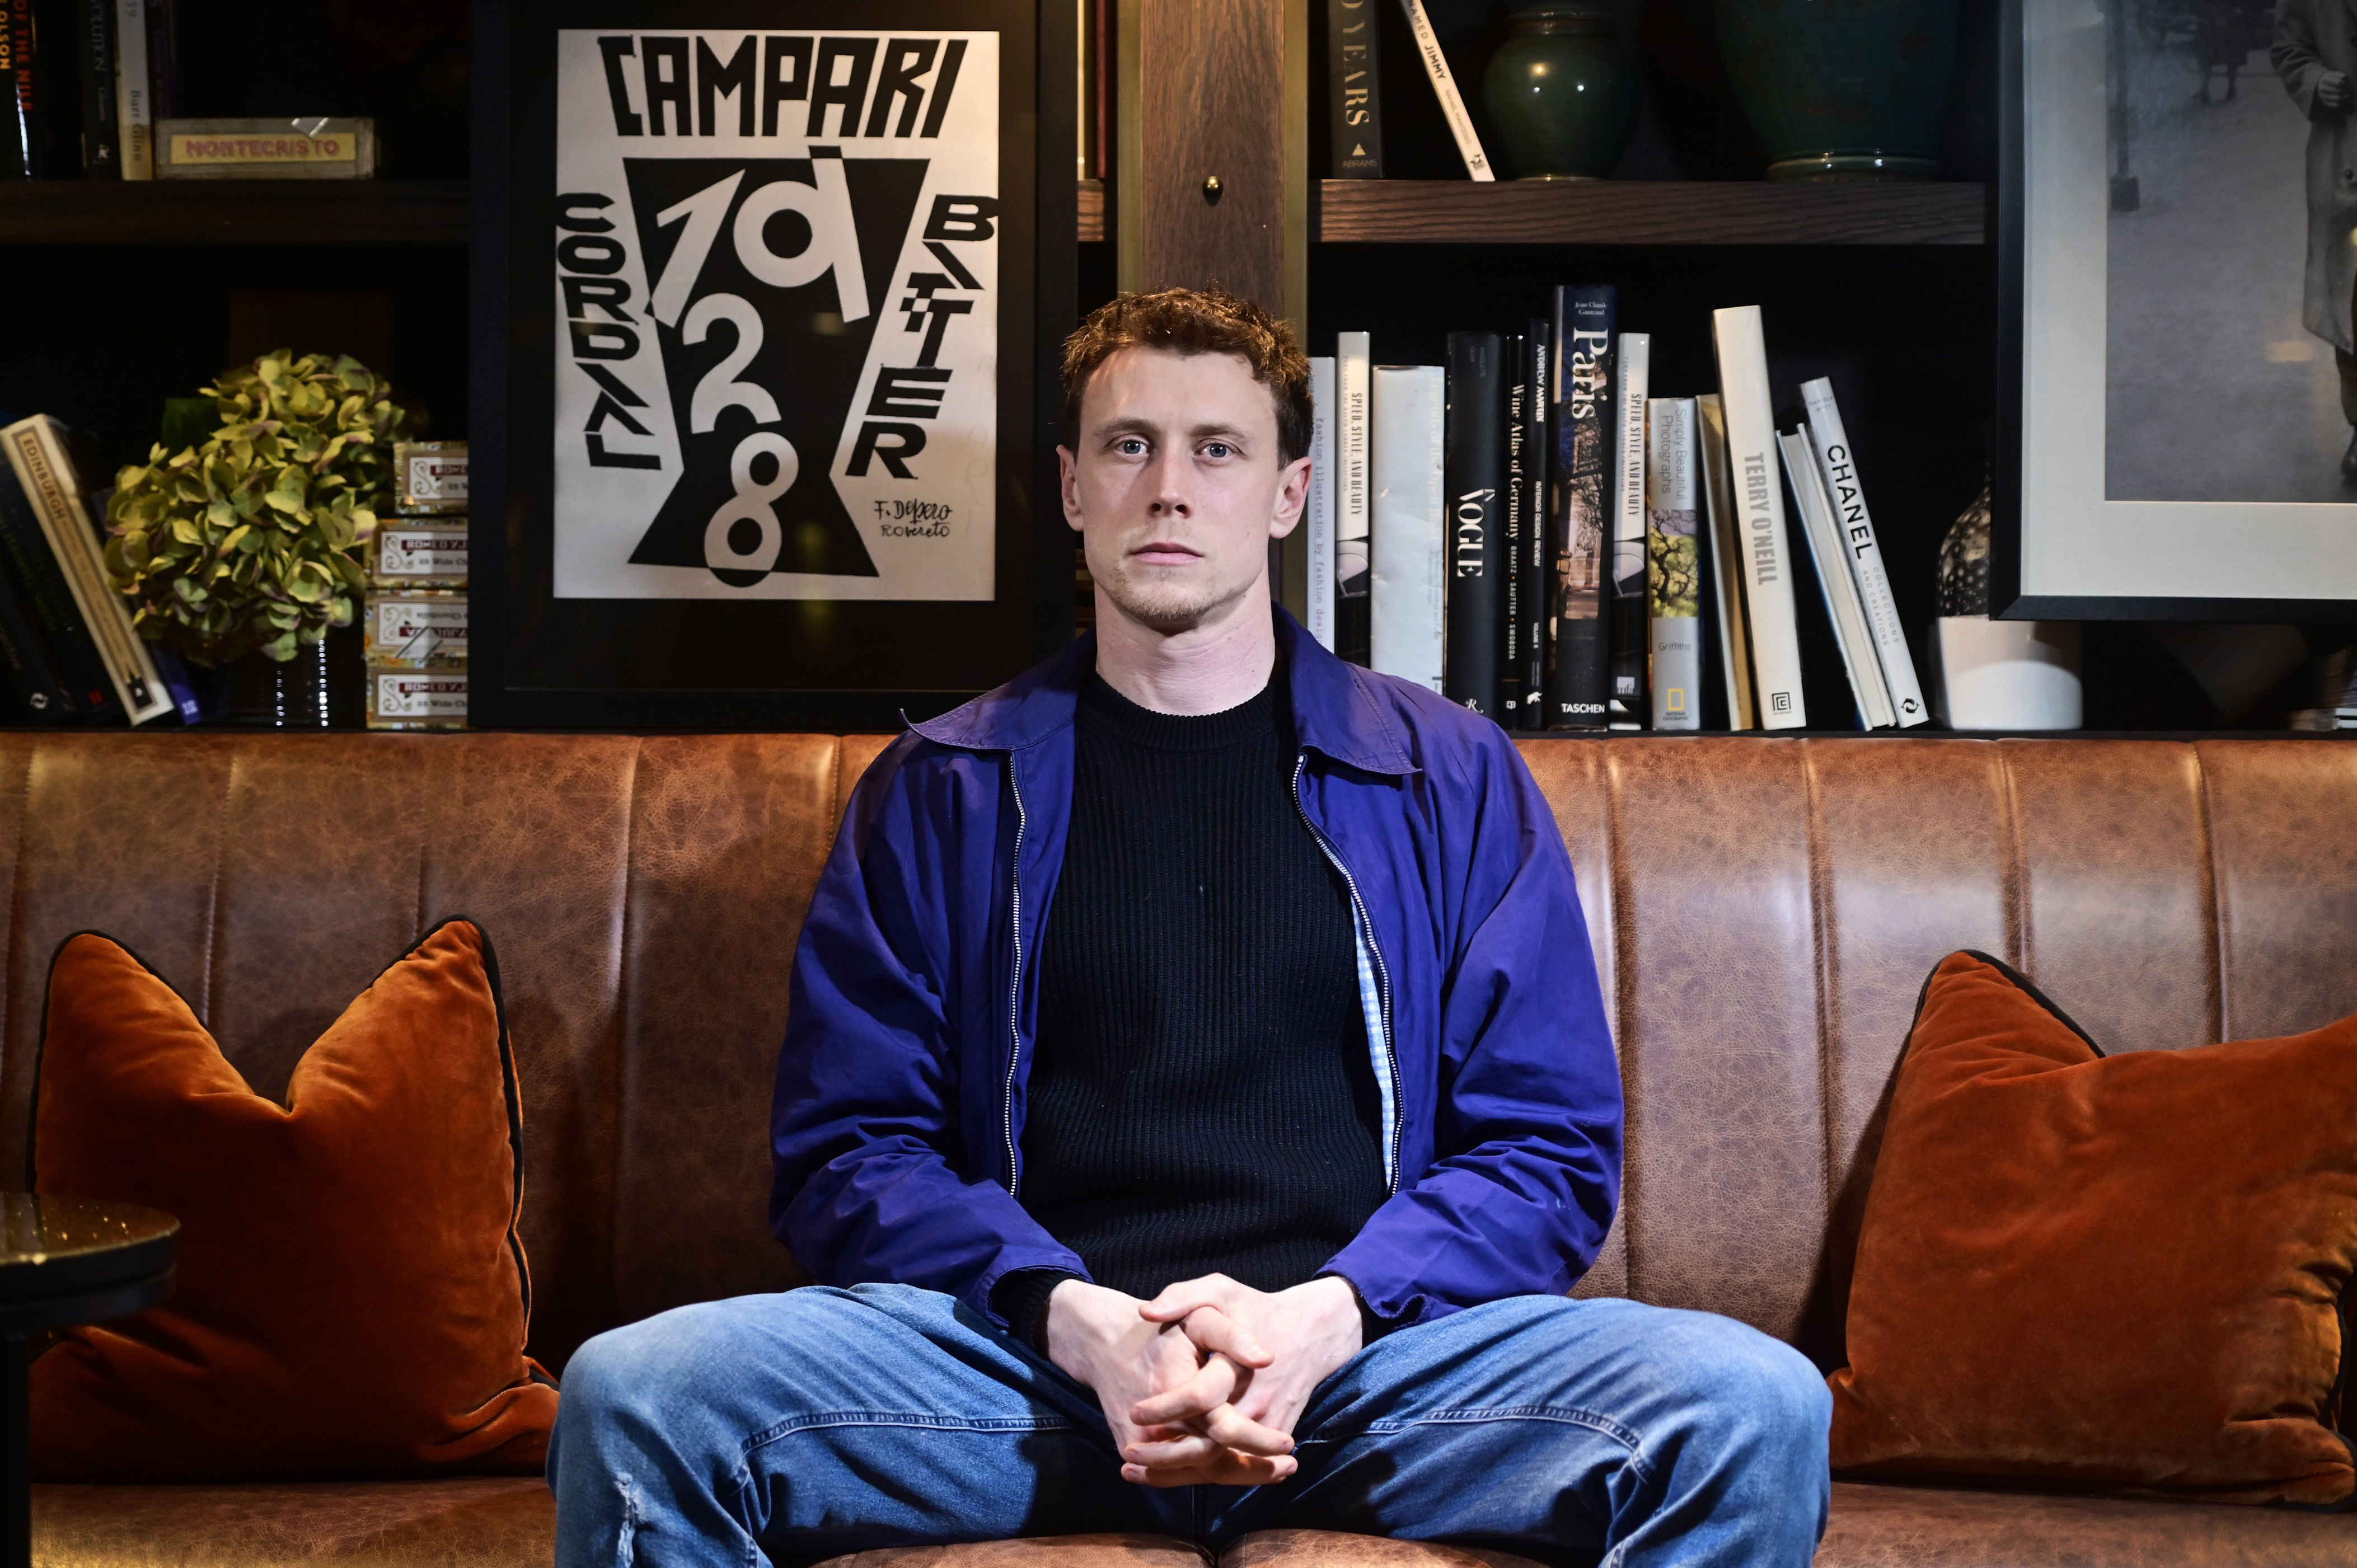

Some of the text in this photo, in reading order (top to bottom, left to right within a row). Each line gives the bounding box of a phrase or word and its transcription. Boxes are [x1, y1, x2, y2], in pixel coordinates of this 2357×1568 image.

[0, 10, 11, 70] OLSON
[13, 0, 34, 111] OF THE NILE
[1342, 20, 1370, 126] YEARS
[1407, 0, 1446, 80] NAMED JIMMY
[598, 34, 969, 139] CAMPARI
[185, 140, 340, 158] MONTECRISTO
[1342, 159, 1378, 167] ABRAMS
[556, 192, 662, 471] CORDIAL
[845, 194, 999, 480] BITTER
[1536, 344, 1545, 422] ANDREW MARTIN
[1572, 327, 1609, 420] Paris
[1315, 417, 1324, 459] fashion
[1349, 392, 1362, 515] SPEED, STYLE, AND BEAUTY
[1505, 384, 1524, 541] Wine Atlas of Germany
[1628, 393, 1642, 515] SPEED, STYLE, AND BEAUTY
[1661, 415, 1674, 494] Photographs
[1675, 408, 1688, 500] Simply Beautiful
[22, 438, 67, 520] EDINBURGH
[874, 500, 891, 520] F.
[1315, 466, 1325, 538] illustration
[1744, 452, 1778, 586] TERRY O'NEILL
[1828, 445, 1875, 560] CHANEL
[1314, 543, 1324, 555] by
[1457, 489, 1484, 578] VOGUE
[1862, 569, 1890, 647] AND CREATIONS
[1873, 566, 1900, 644] COLLECTIONS
[1658, 641, 1691, 652] Griffiths
[1562, 703, 1605, 714] TASCHEN
